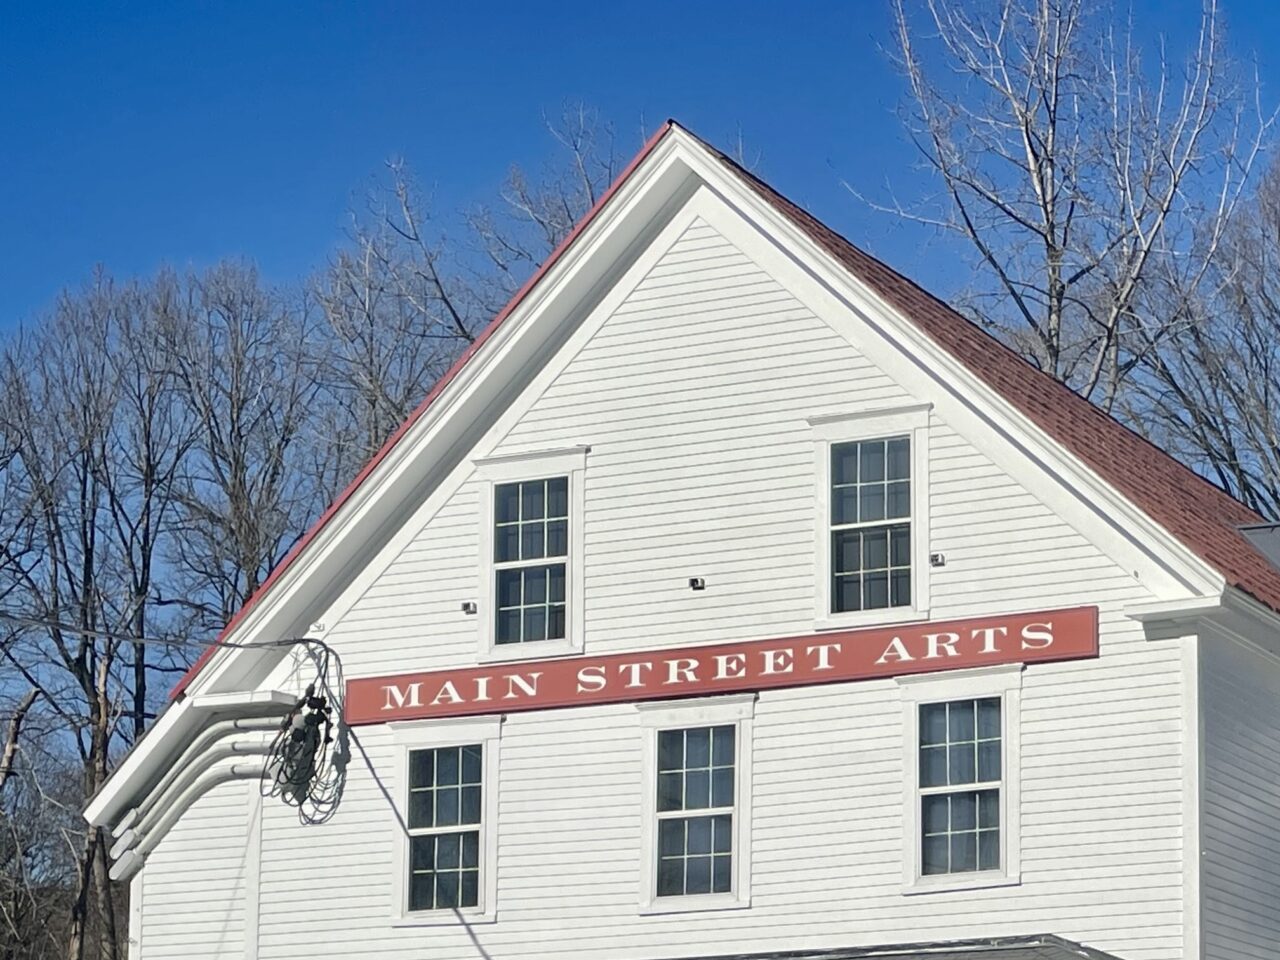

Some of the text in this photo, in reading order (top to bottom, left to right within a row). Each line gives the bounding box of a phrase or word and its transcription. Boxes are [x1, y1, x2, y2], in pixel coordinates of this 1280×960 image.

[380, 621, 1054, 711] MAIN STREET ARTS
